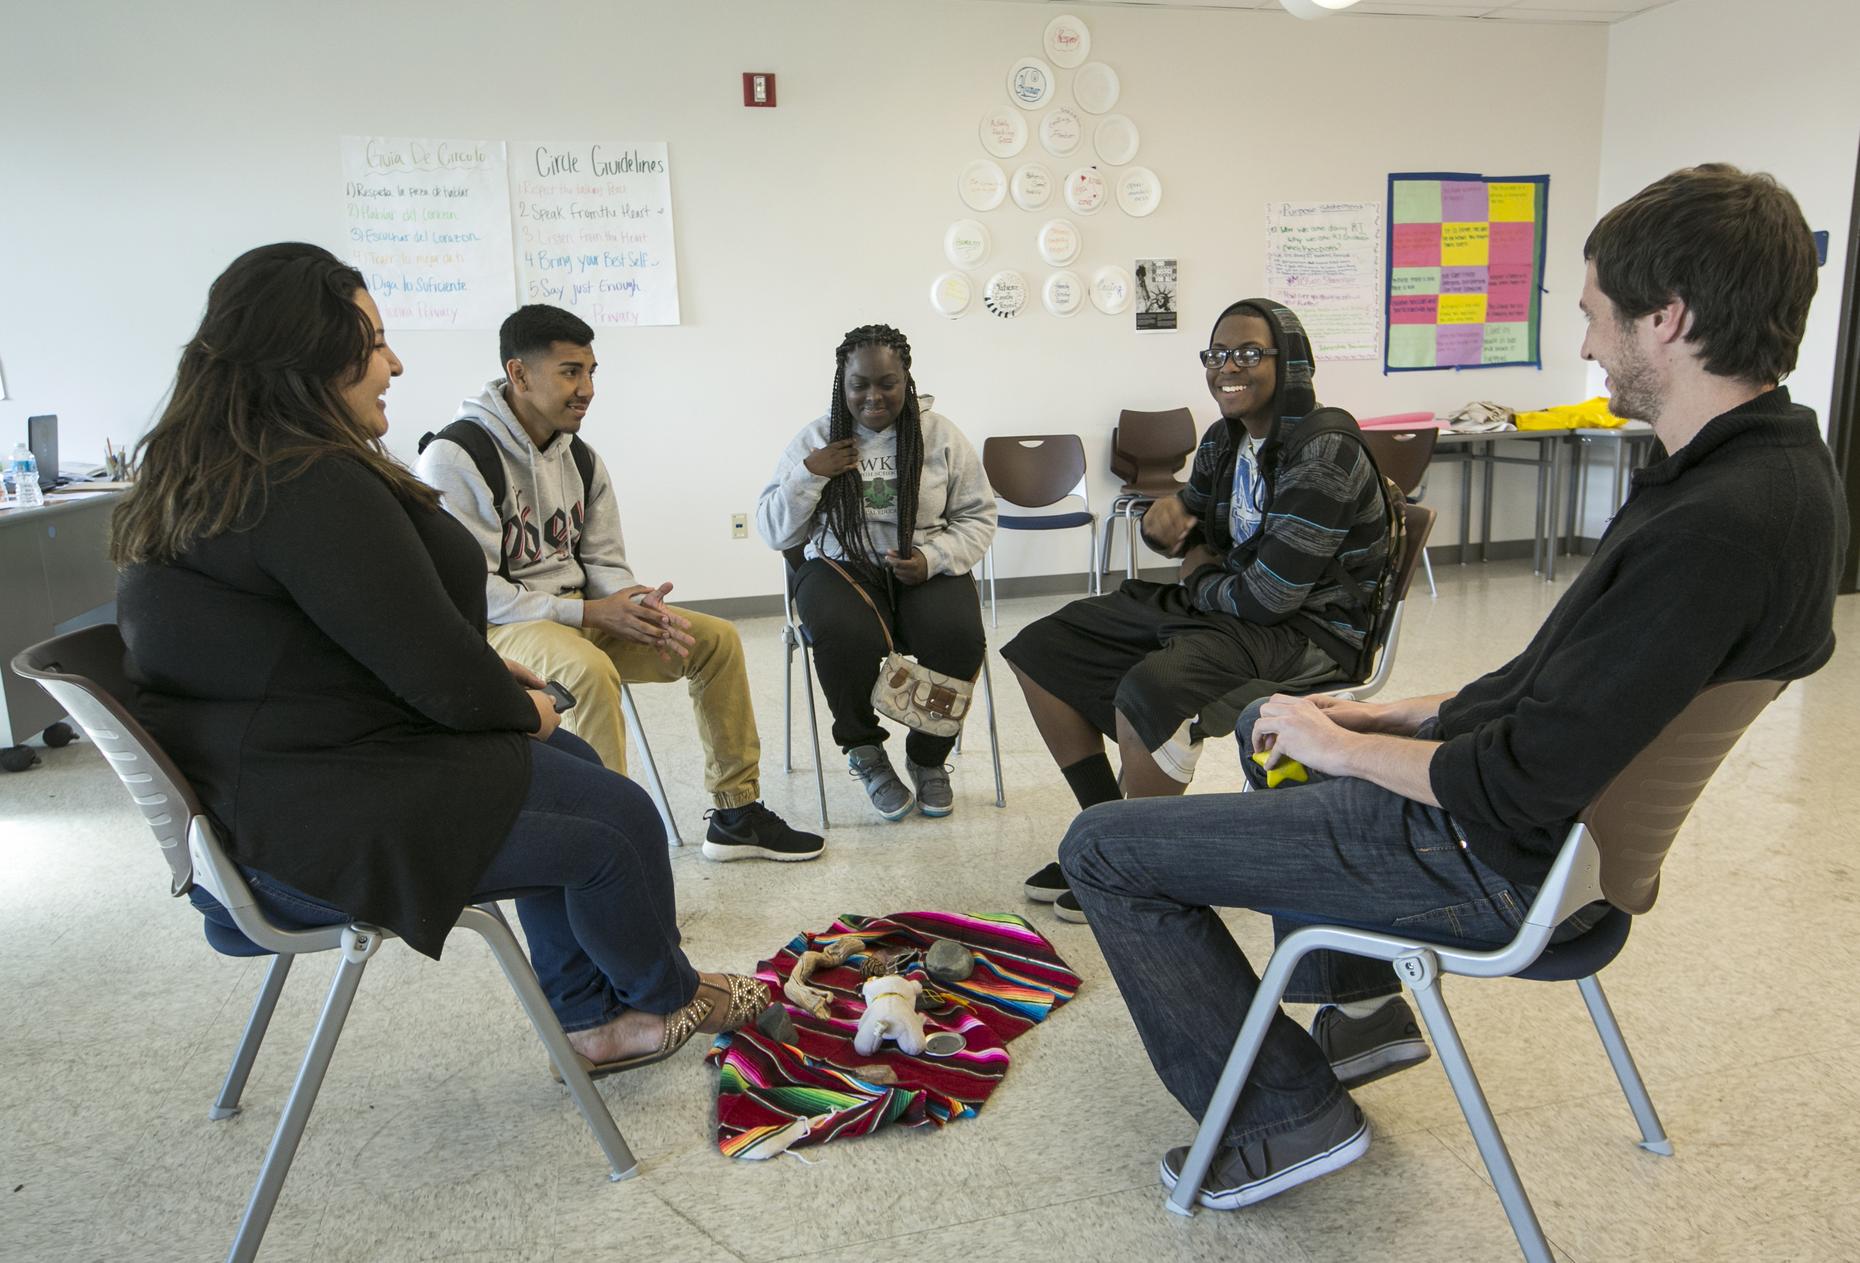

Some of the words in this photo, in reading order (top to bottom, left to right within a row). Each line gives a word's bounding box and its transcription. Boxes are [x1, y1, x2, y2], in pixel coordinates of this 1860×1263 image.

[535, 146, 580, 177] Circle
[591, 145, 665, 177] Guidelines
[531, 203, 563, 222] Speak
[621, 203, 650, 219] Heart
[538, 250, 573, 274] Bring
[577, 255, 599, 272] your
[604, 251, 625, 268] Best
[628, 251, 648, 268] Self
[540, 279, 563, 300] Say
[599, 279, 641, 296] Enough
[593, 303, 640, 324] Privacy
[860, 456, 897, 472] WK
